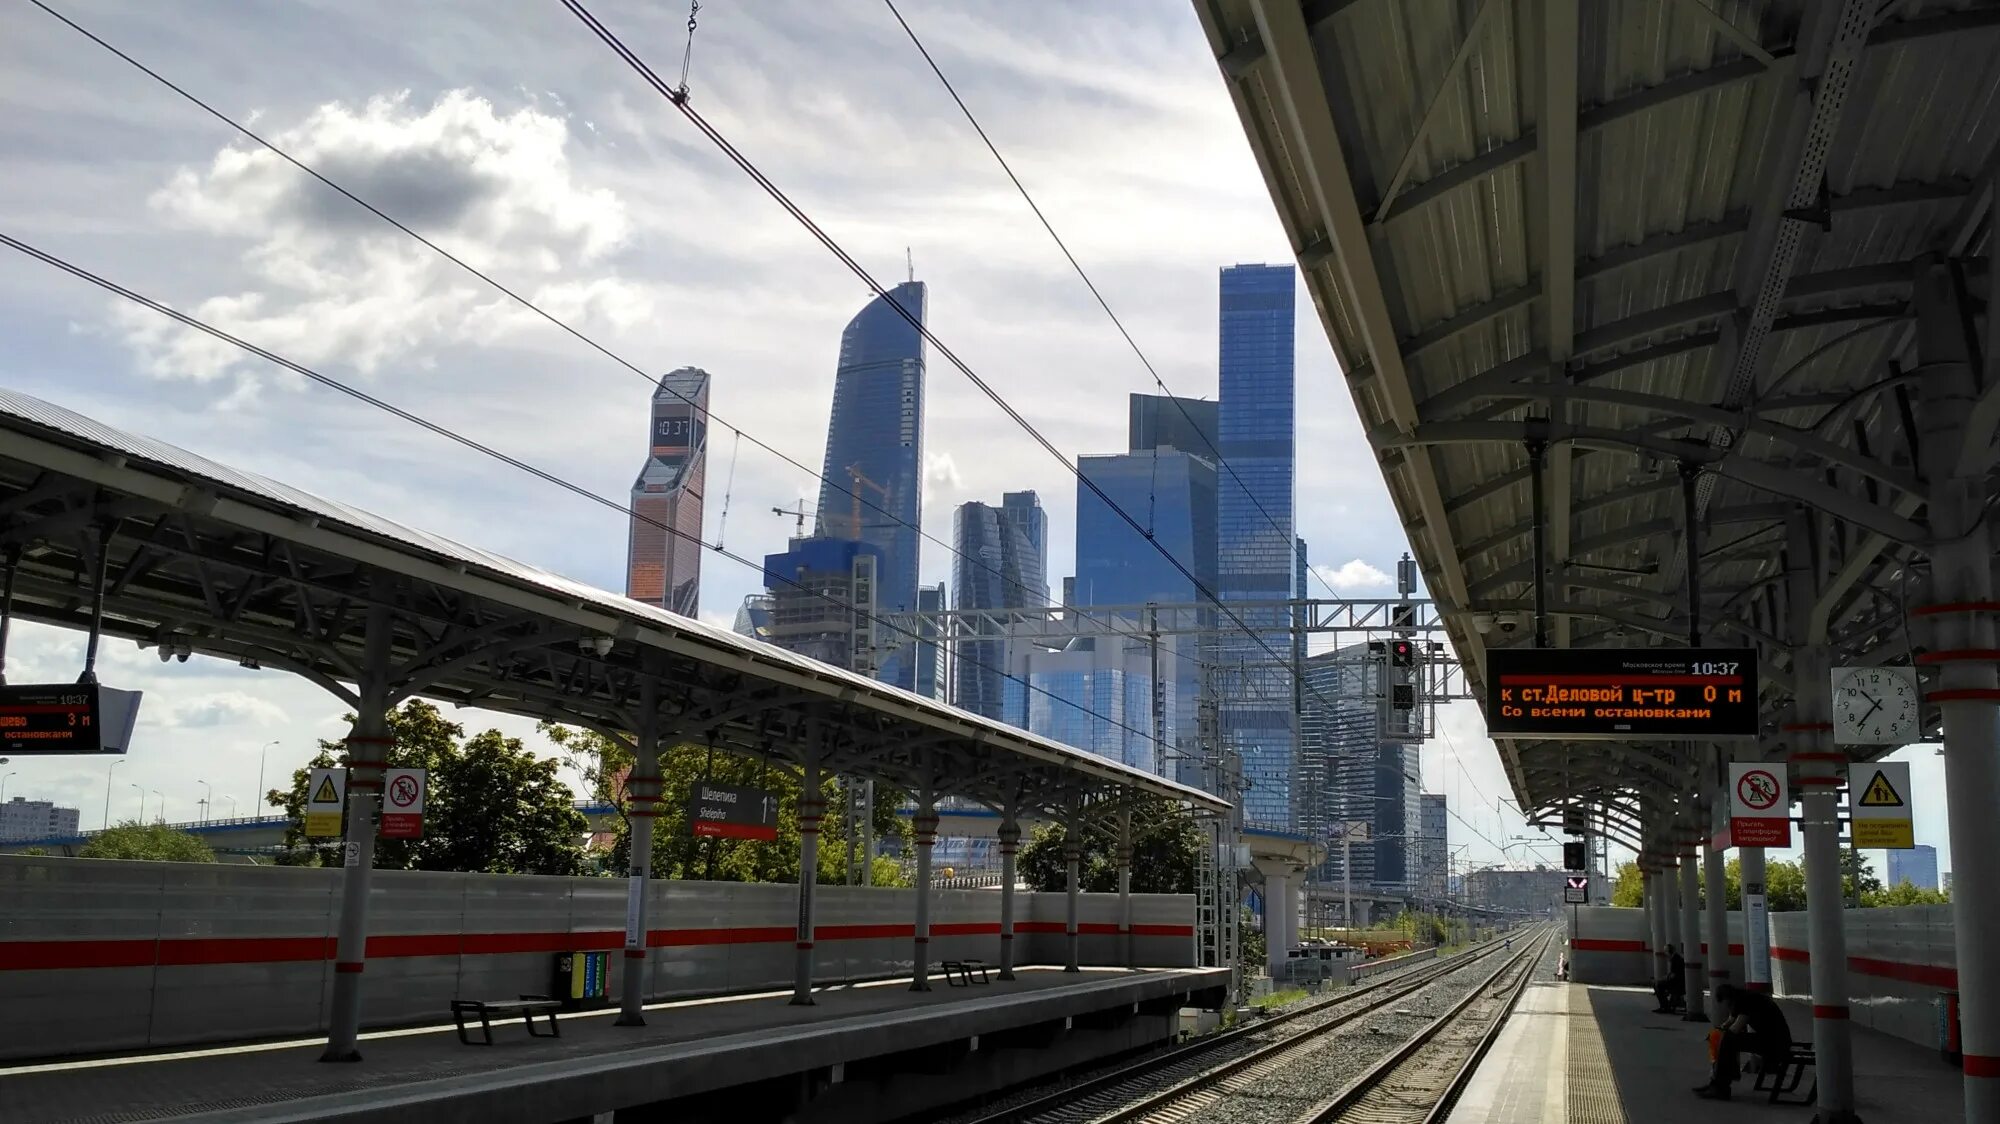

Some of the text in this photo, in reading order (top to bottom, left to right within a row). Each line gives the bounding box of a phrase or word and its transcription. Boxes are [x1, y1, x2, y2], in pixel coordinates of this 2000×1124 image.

[658, 421, 689, 435] 10 37
[1691, 661, 1739, 675] 10:37
[1857, 678, 1865, 687] 11
[1870, 674, 1879, 683] 12
[1888, 678, 1891, 686] 1
[1501, 688, 1512, 701] к
[1521, 684, 1623, 704] ст.Деловой
[1632, 688, 1676, 704] ц-тр
[1728, 688, 1742, 703] м
[1847, 688, 1857, 697] 10
[1897, 687, 1904, 696] 2
[60, 694, 89, 705] 10:37
[1843, 701, 1849, 710] 9
[1903, 700, 1909, 709] 3
[1501, 705, 1711, 719] Со всеми остановками
[1899, 712, 1905, 721] 4
[68, 712, 76, 726] 3
[82, 715, 90, 726] м
[1848, 713, 1855, 722] 8
[1874, 727, 1881, 736] 6
[1891, 722, 1898, 732] 5
[4, 731, 73, 739] остановками
[701, 786, 737, 804] Шелепиха
[762, 796, 768, 824] 1
